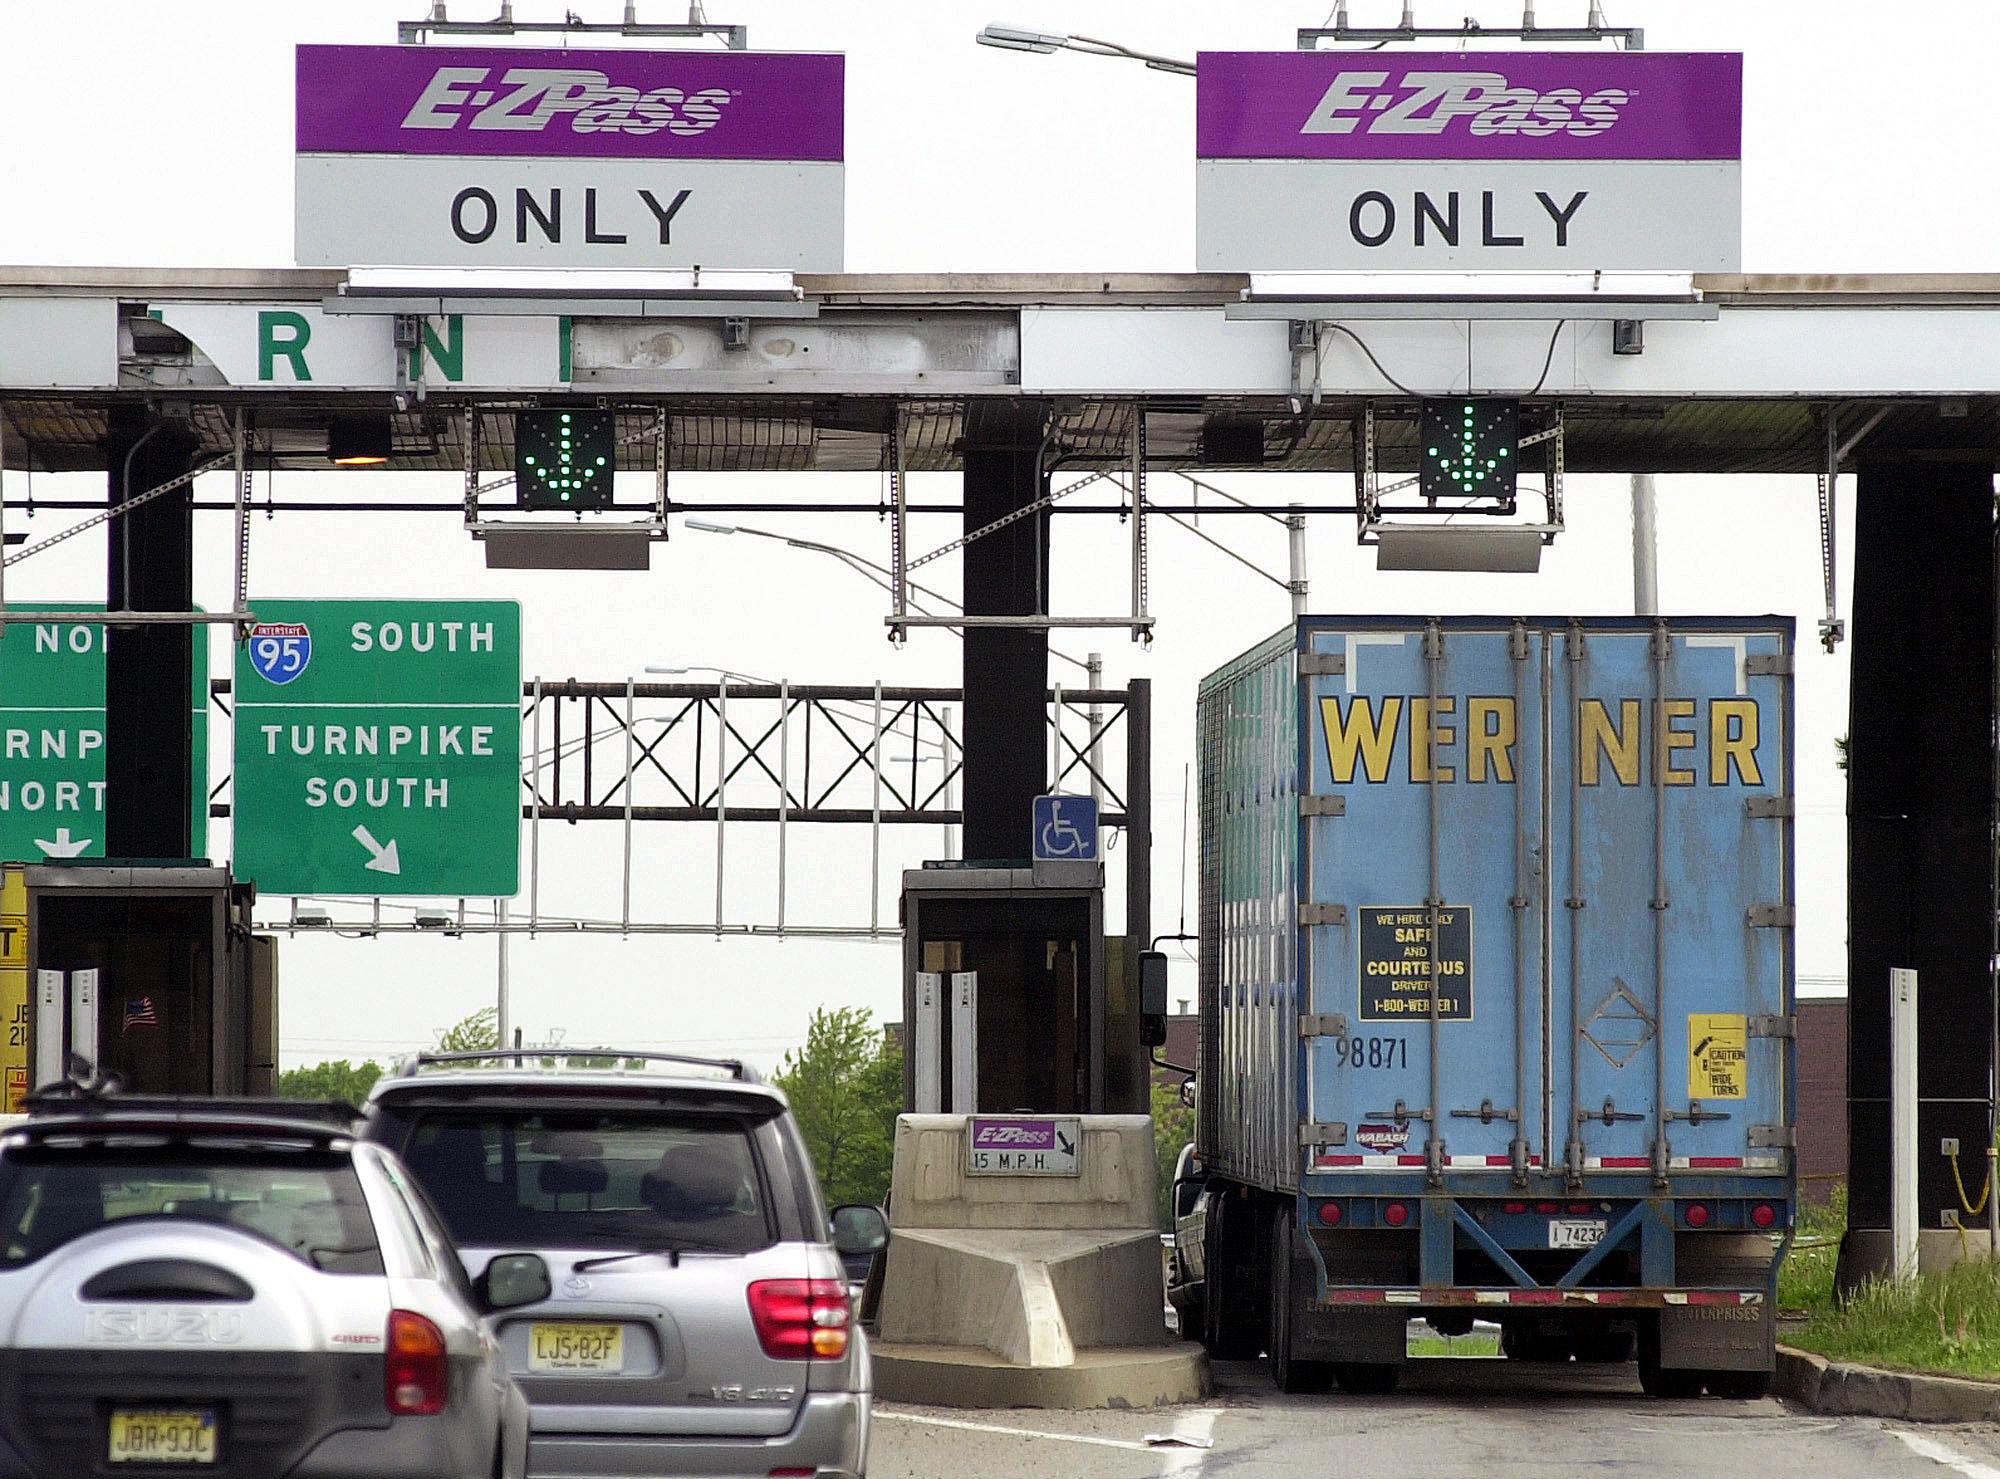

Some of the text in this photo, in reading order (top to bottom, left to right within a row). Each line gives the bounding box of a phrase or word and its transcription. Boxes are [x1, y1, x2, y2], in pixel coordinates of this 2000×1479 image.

[450, 186, 693, 245] ONLY
[1349, 190, 1589, 247] ONLY
[35, 624, 107, 653] NO
[351, 621, 495, 652] SOUTH
[258, 638, 301, 672] 95
[260, 725, 495, 756] TURNPIKE
[305, 777, 449, 808] SOUTH
[1376, 915, 1395, 925] WE
[1403, 947, 1428, 957] AND
[1374, 999, 1451, 1012] 1-800-WERER
[1336, 1037, 1407, 1069] 98871
[1356, 1132, 1409, 1143] WABASH
[975, 1153, 1051, 1169] 15 M.P.H.
[83, 1310, 243, 1343] ISUZU
